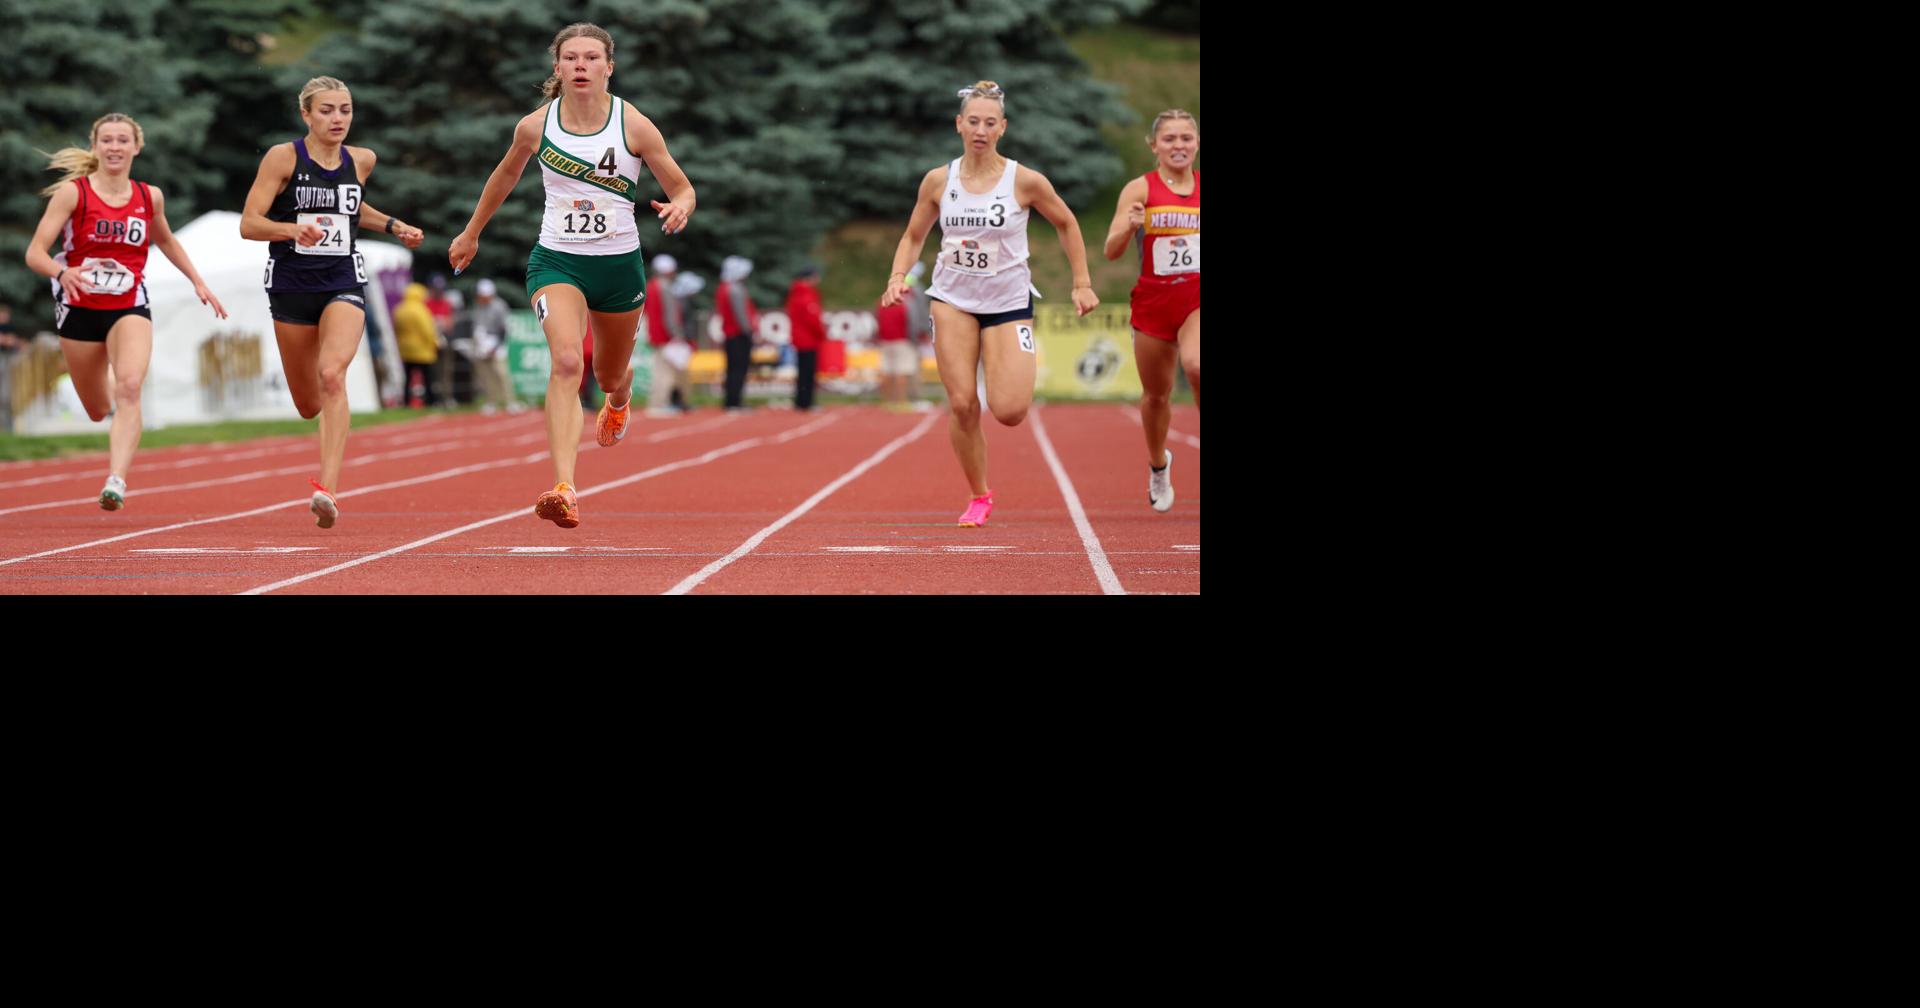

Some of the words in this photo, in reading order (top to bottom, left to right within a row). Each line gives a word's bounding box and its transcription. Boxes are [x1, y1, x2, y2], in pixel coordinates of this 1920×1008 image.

[541, 146, 589, 176] KEARNEY
[598, 147, 617, 175] 4
[294, 186, 336, 209] SOUTHERN
[345, 187, 358, 212] 5
[564, 213, 607, 233] 128
[989, 203, 1005, 227] 3
[1151, 211, 1200, 229] NEUMA
[128, 220, 142, 243] 6
[318, 229, 343, 247] 24
[953, 250, 989, 269] 138
[1169, 249, 1193, 267] 26
[91, 271, 127, 287] 177
[537, 298, 546, 321] 4
[1019, 327, 1033, 350] 3
